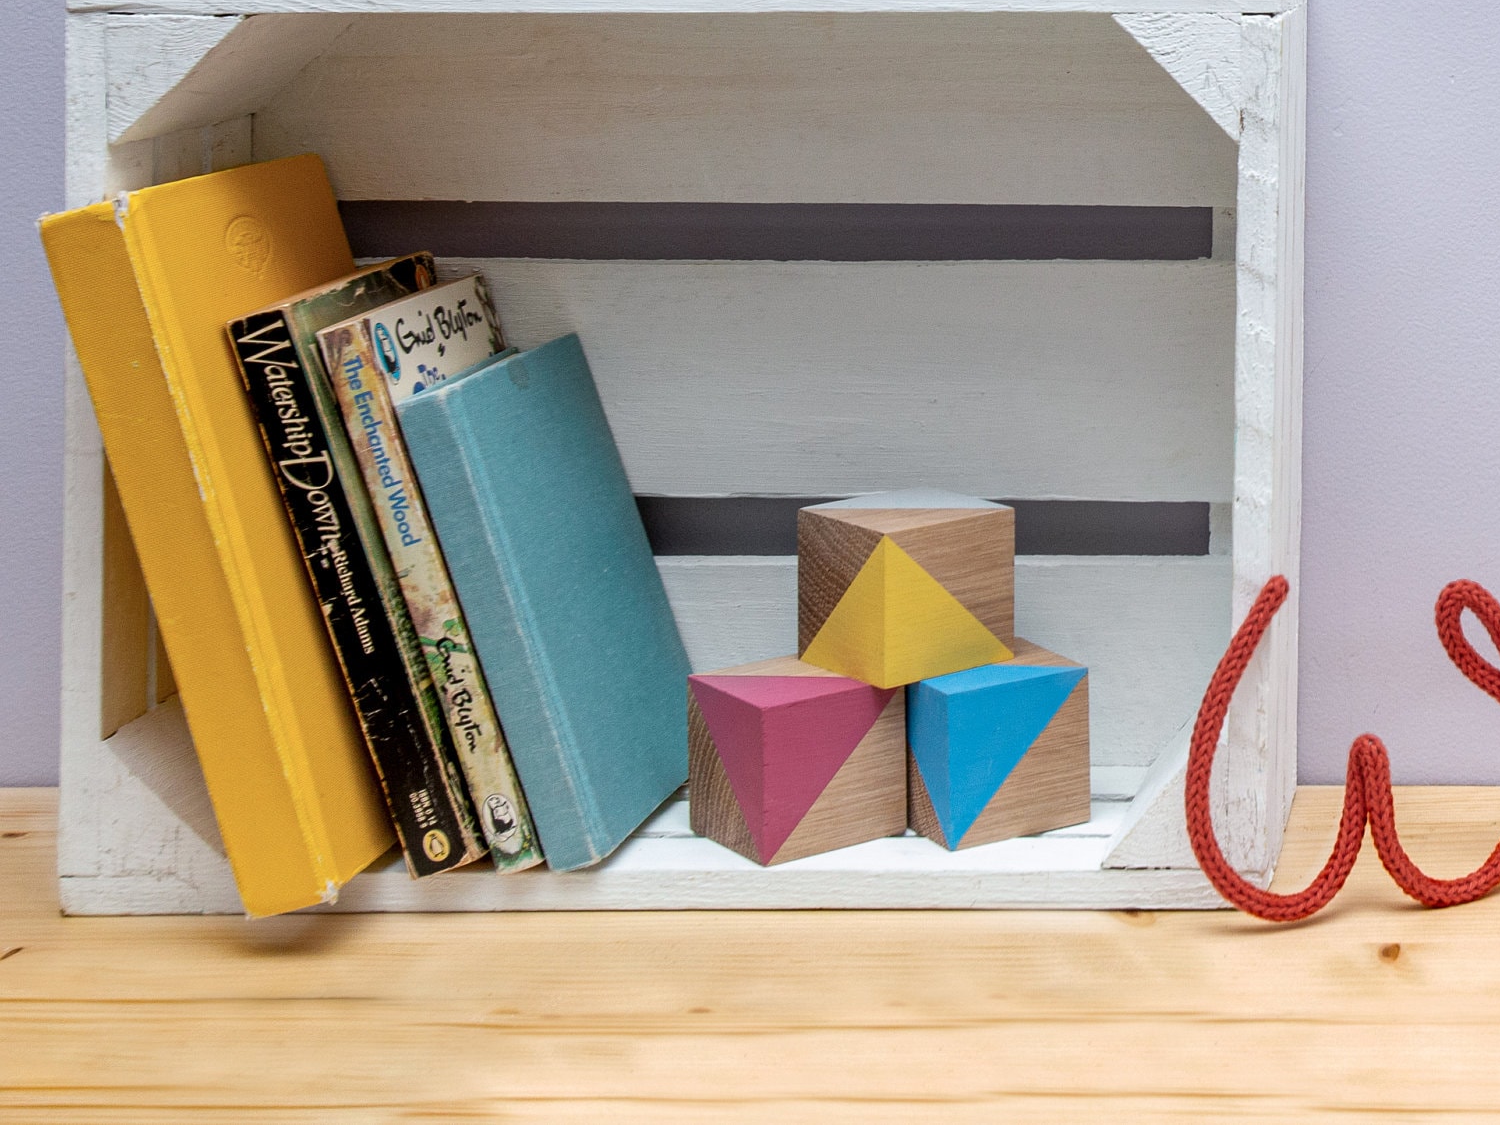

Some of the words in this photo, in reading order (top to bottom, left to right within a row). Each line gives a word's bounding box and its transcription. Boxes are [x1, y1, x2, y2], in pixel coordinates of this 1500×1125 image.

[395, 310, 435, 354] Enid
[433, 299, 483, 342] Blyton
[343, 355, 364, 391] The
[237, 319, 313, 459] Watership
[278, 449, 342, 541] Down
[353, 390, 403, 490] Enchanted
[387, 488, 422, 548] Wood
[330, 549, 362, 607] Richard
[349, 607, 376, 655] Adams
[451, 687, 482, 754] Blyton
